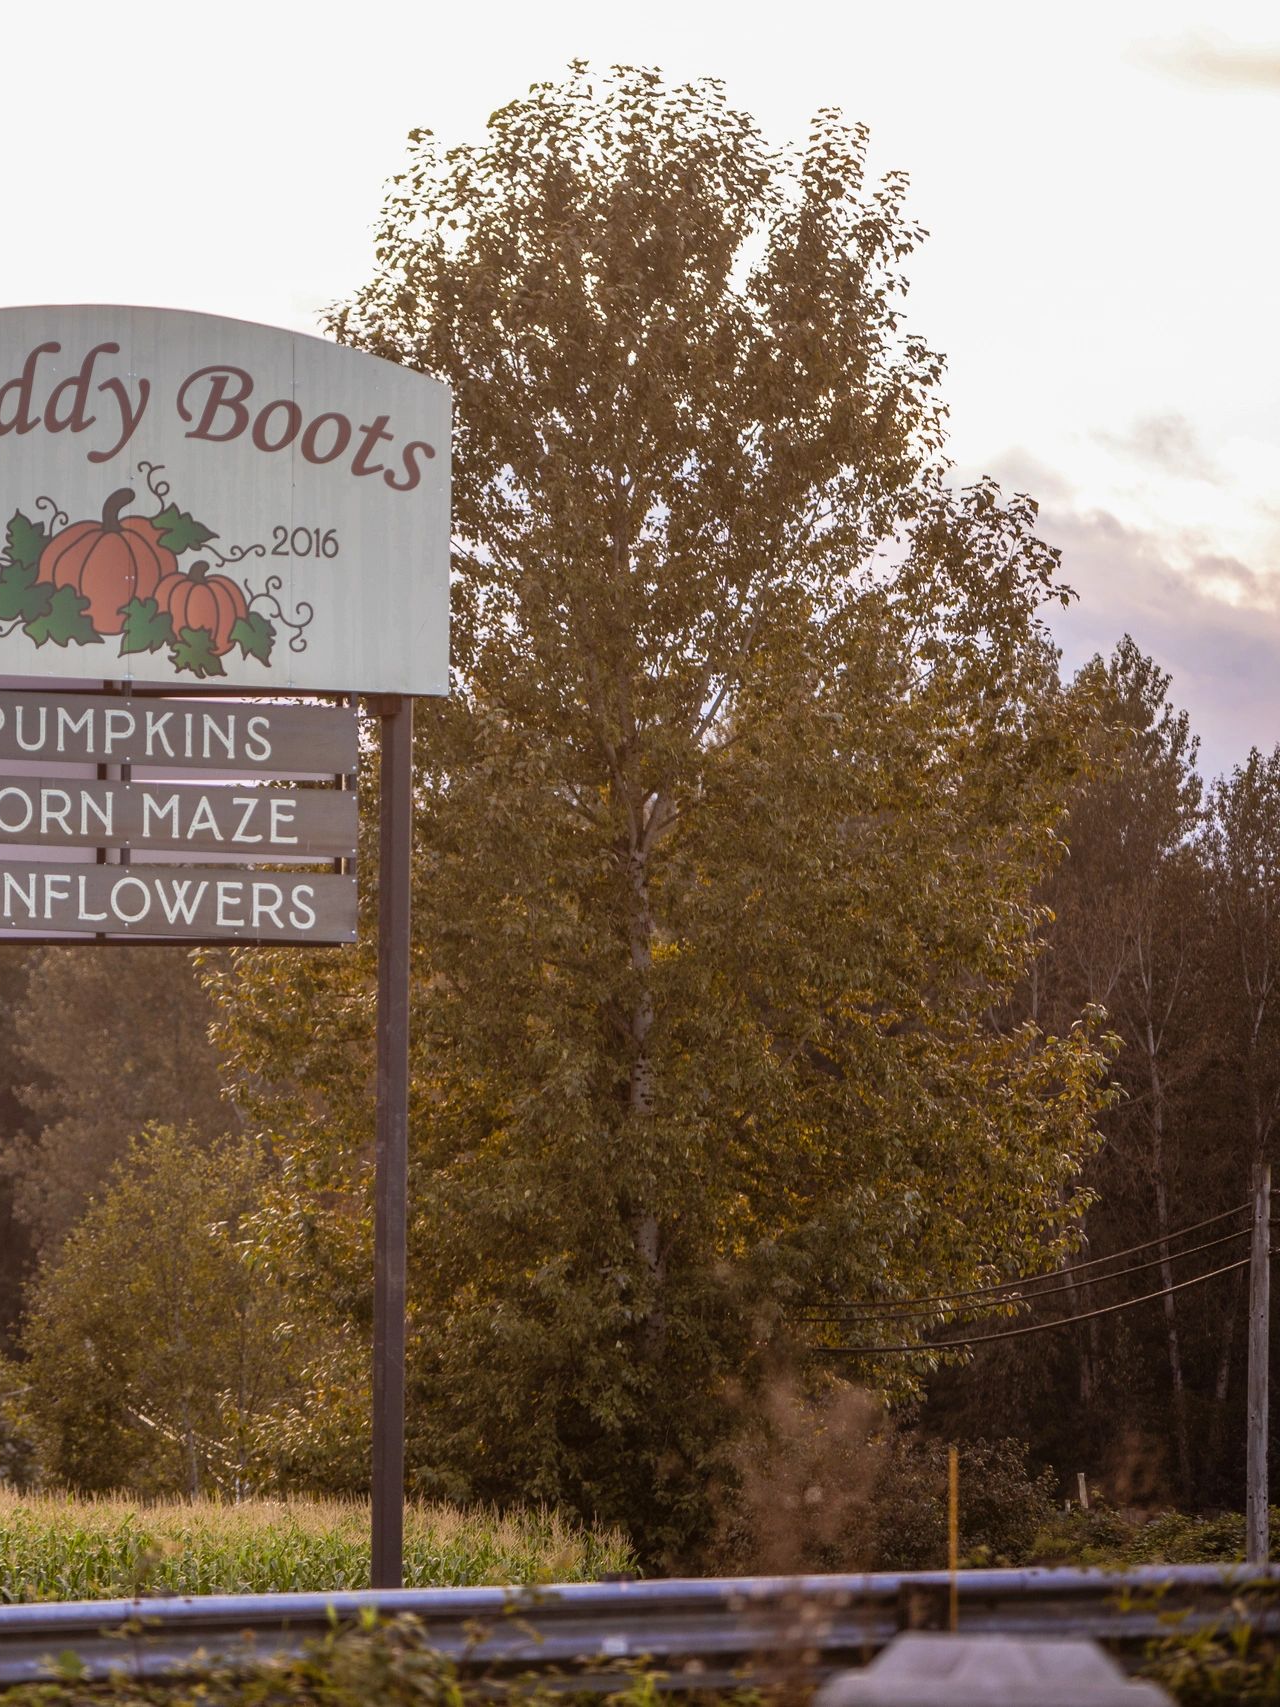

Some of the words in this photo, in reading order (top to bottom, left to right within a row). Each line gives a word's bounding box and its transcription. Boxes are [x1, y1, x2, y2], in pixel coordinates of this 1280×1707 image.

[177, 365, 435, 491] Boots
[271, 526, 339, 558] 2016
[142, 793, 298, 844] MAZE
